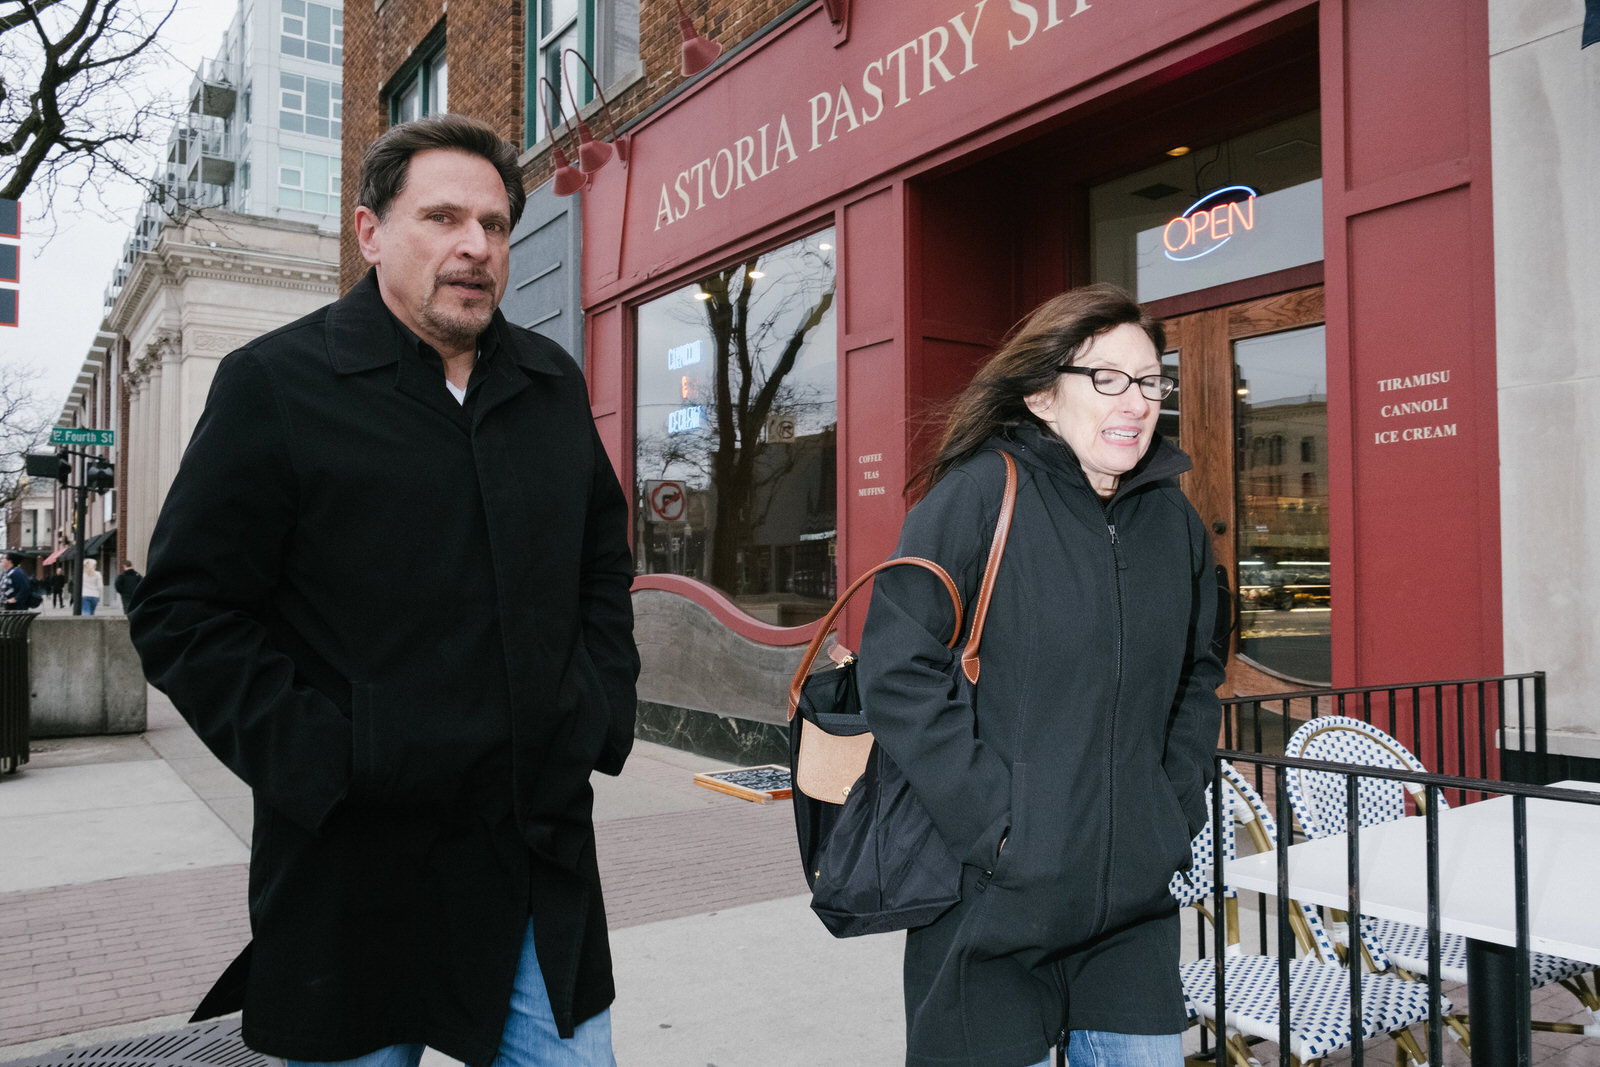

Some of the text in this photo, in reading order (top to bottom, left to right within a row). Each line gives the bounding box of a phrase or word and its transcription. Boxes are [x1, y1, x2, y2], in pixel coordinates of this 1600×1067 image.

[654, 114, 798, 231] ASTORIA
[808, 0, 988, 152] PASTRY
[1163, 195, 1254, 251] OPEN
[1377, 370, 1450, 392] TIRAMISU
[1381, 398, 1448, 417] CANNOLI
[65, 431, 97, 443] Fourth
[101, 433, 113, 444] St
[1374, 424, 1457, 444] ICE CREAM
[858, 453, 882, 464] COFFEE
[864, 471, 879, 480] TEAS
[858, 487, 885, 496] MUFFINS
